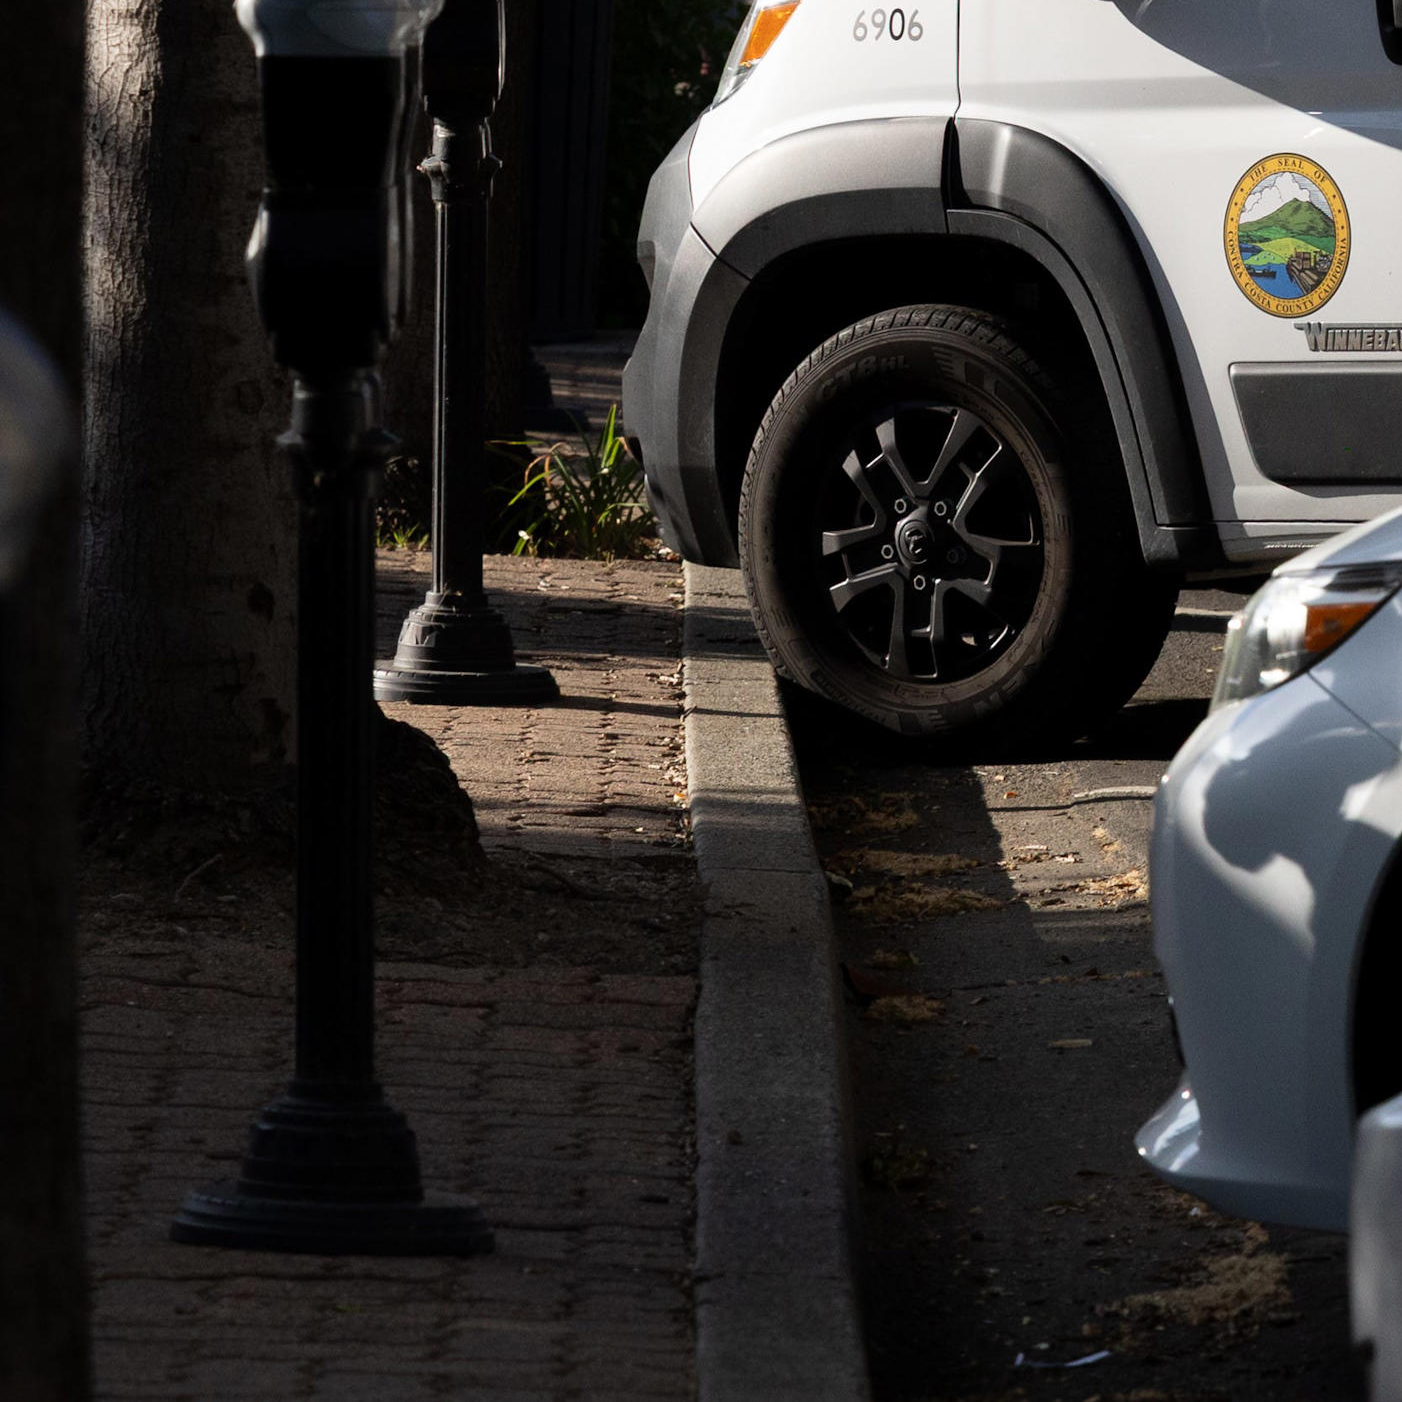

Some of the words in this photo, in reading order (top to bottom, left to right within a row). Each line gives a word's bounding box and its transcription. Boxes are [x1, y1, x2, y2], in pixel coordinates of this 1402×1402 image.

[853, 7, 924, 42] 6906
[1248, 165, 1268, 182] THE
[1277, 158, 1304, 170] SEAL
[1313, 169, 1328, 183] OF
[1227, 230, 1243, 279] CONTRA
[1244, 281, 1272, 309] COSTA
[1275, 297, 1315, 313] COUNTY
[1318, 237, 1347, 301] CALIFORNIA
